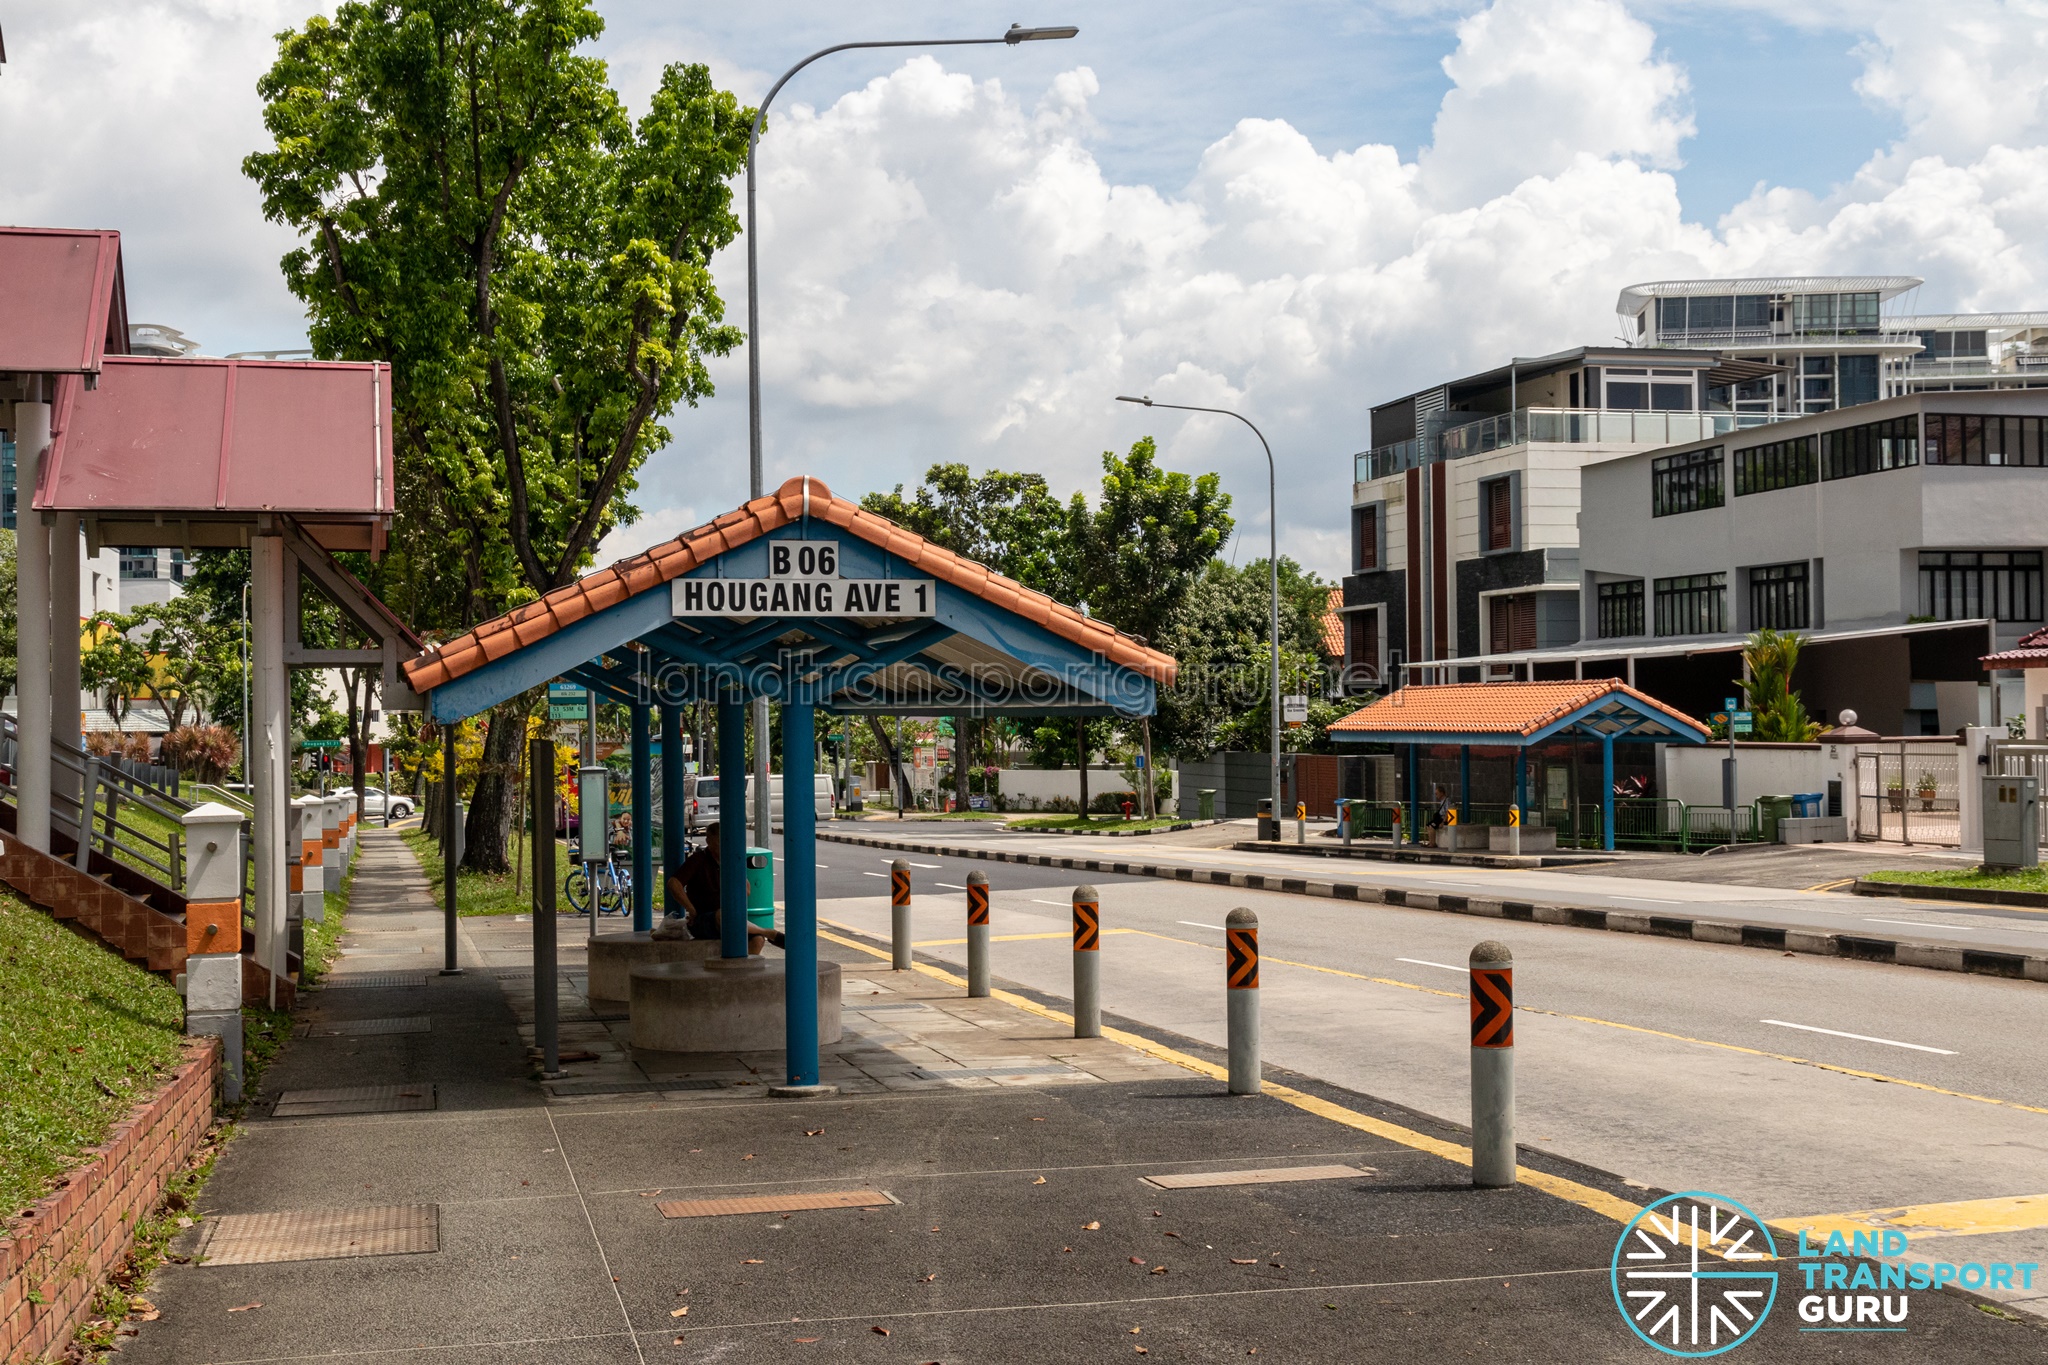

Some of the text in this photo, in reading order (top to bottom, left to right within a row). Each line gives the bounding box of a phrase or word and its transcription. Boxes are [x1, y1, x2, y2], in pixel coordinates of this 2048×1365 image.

[772, 546, 836, 575] B 06
[685, 581, 927, 612] HOUGANG AVE 1
